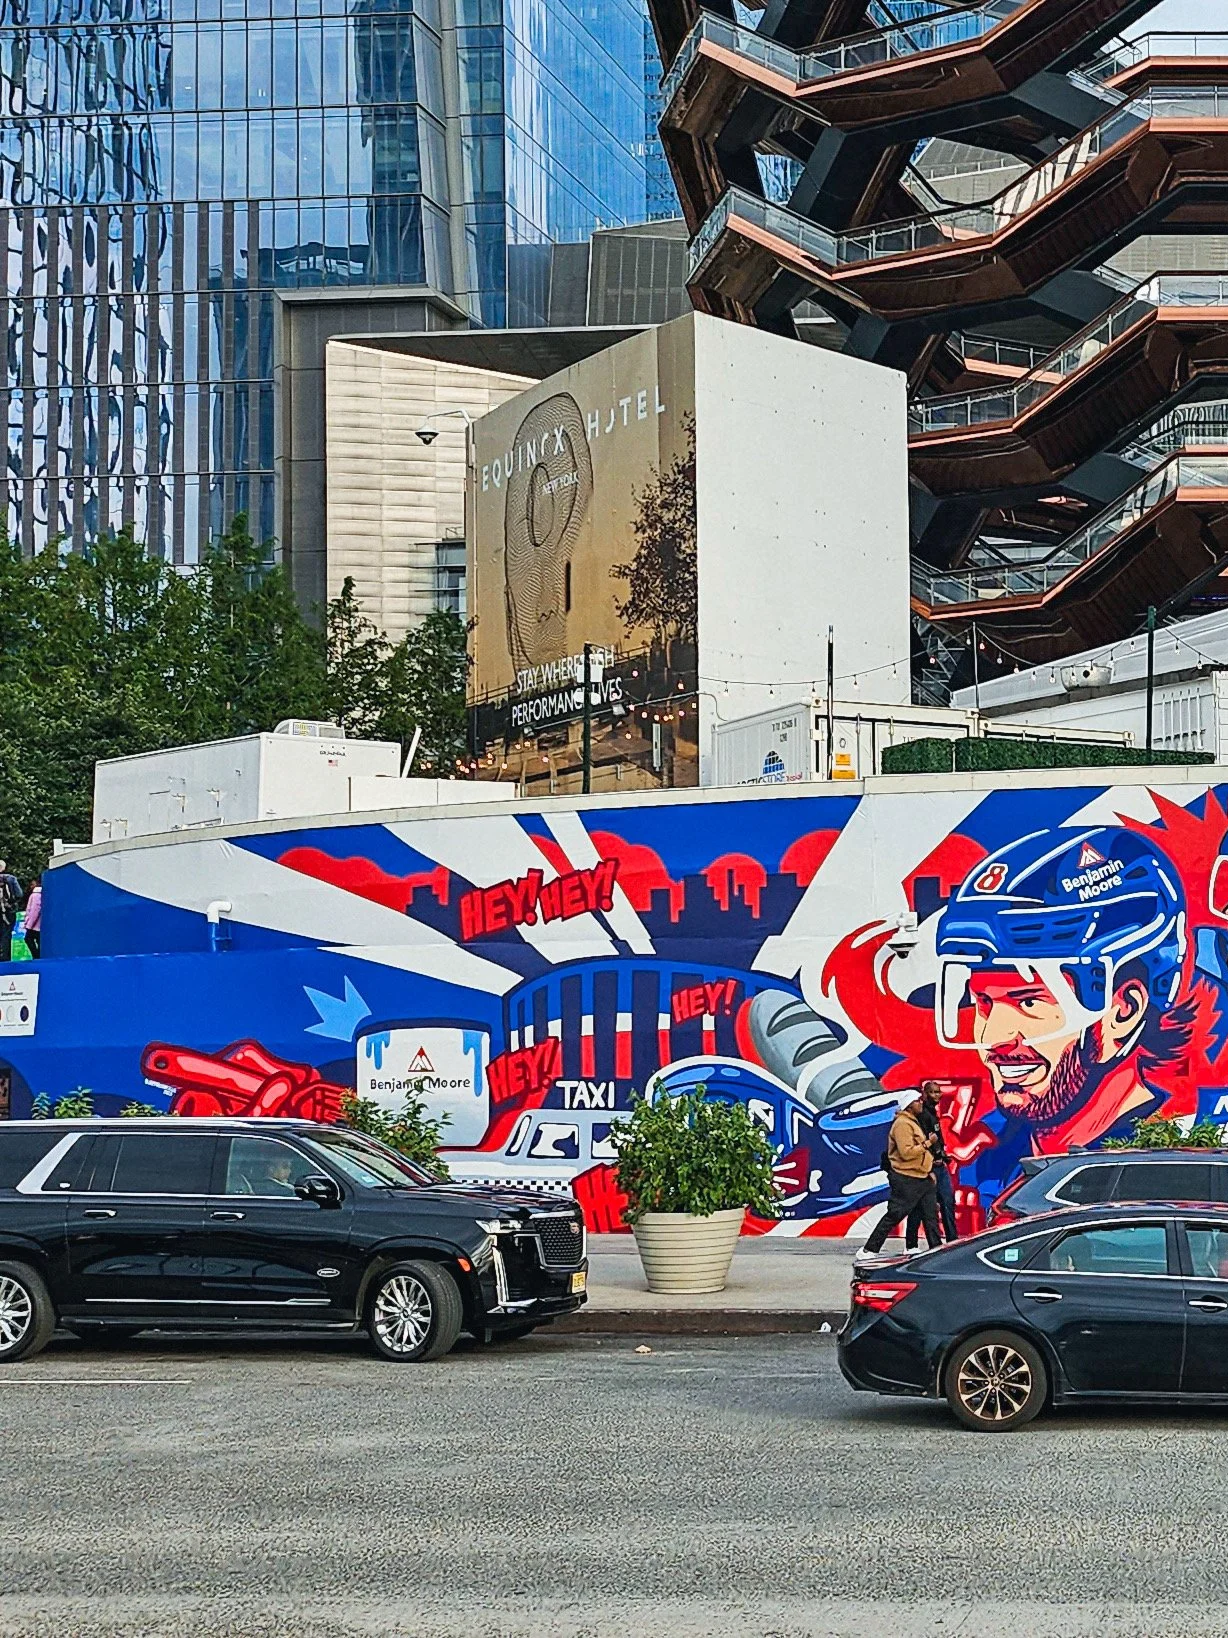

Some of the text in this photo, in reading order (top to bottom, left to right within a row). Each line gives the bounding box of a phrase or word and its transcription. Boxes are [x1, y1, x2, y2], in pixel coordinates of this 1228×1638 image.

[516, 664, 540, 696] STAY
[511, 686, 586, 728] PERFORMANC
[974, 863, 1009, 893] 8
[1061, 859, 1125, 893] Benjamin
[1078, 874, 1123, 902] Moore
[460, 858, 618, 941] HEY! HEY!
[671, 977, 738, 1024] HEY!
[370, 1077, 471, 1094] Benjam Moore
[487, 1036, 558, 1103] HEY!
[555, 1080, 616, 1110] TAXI
